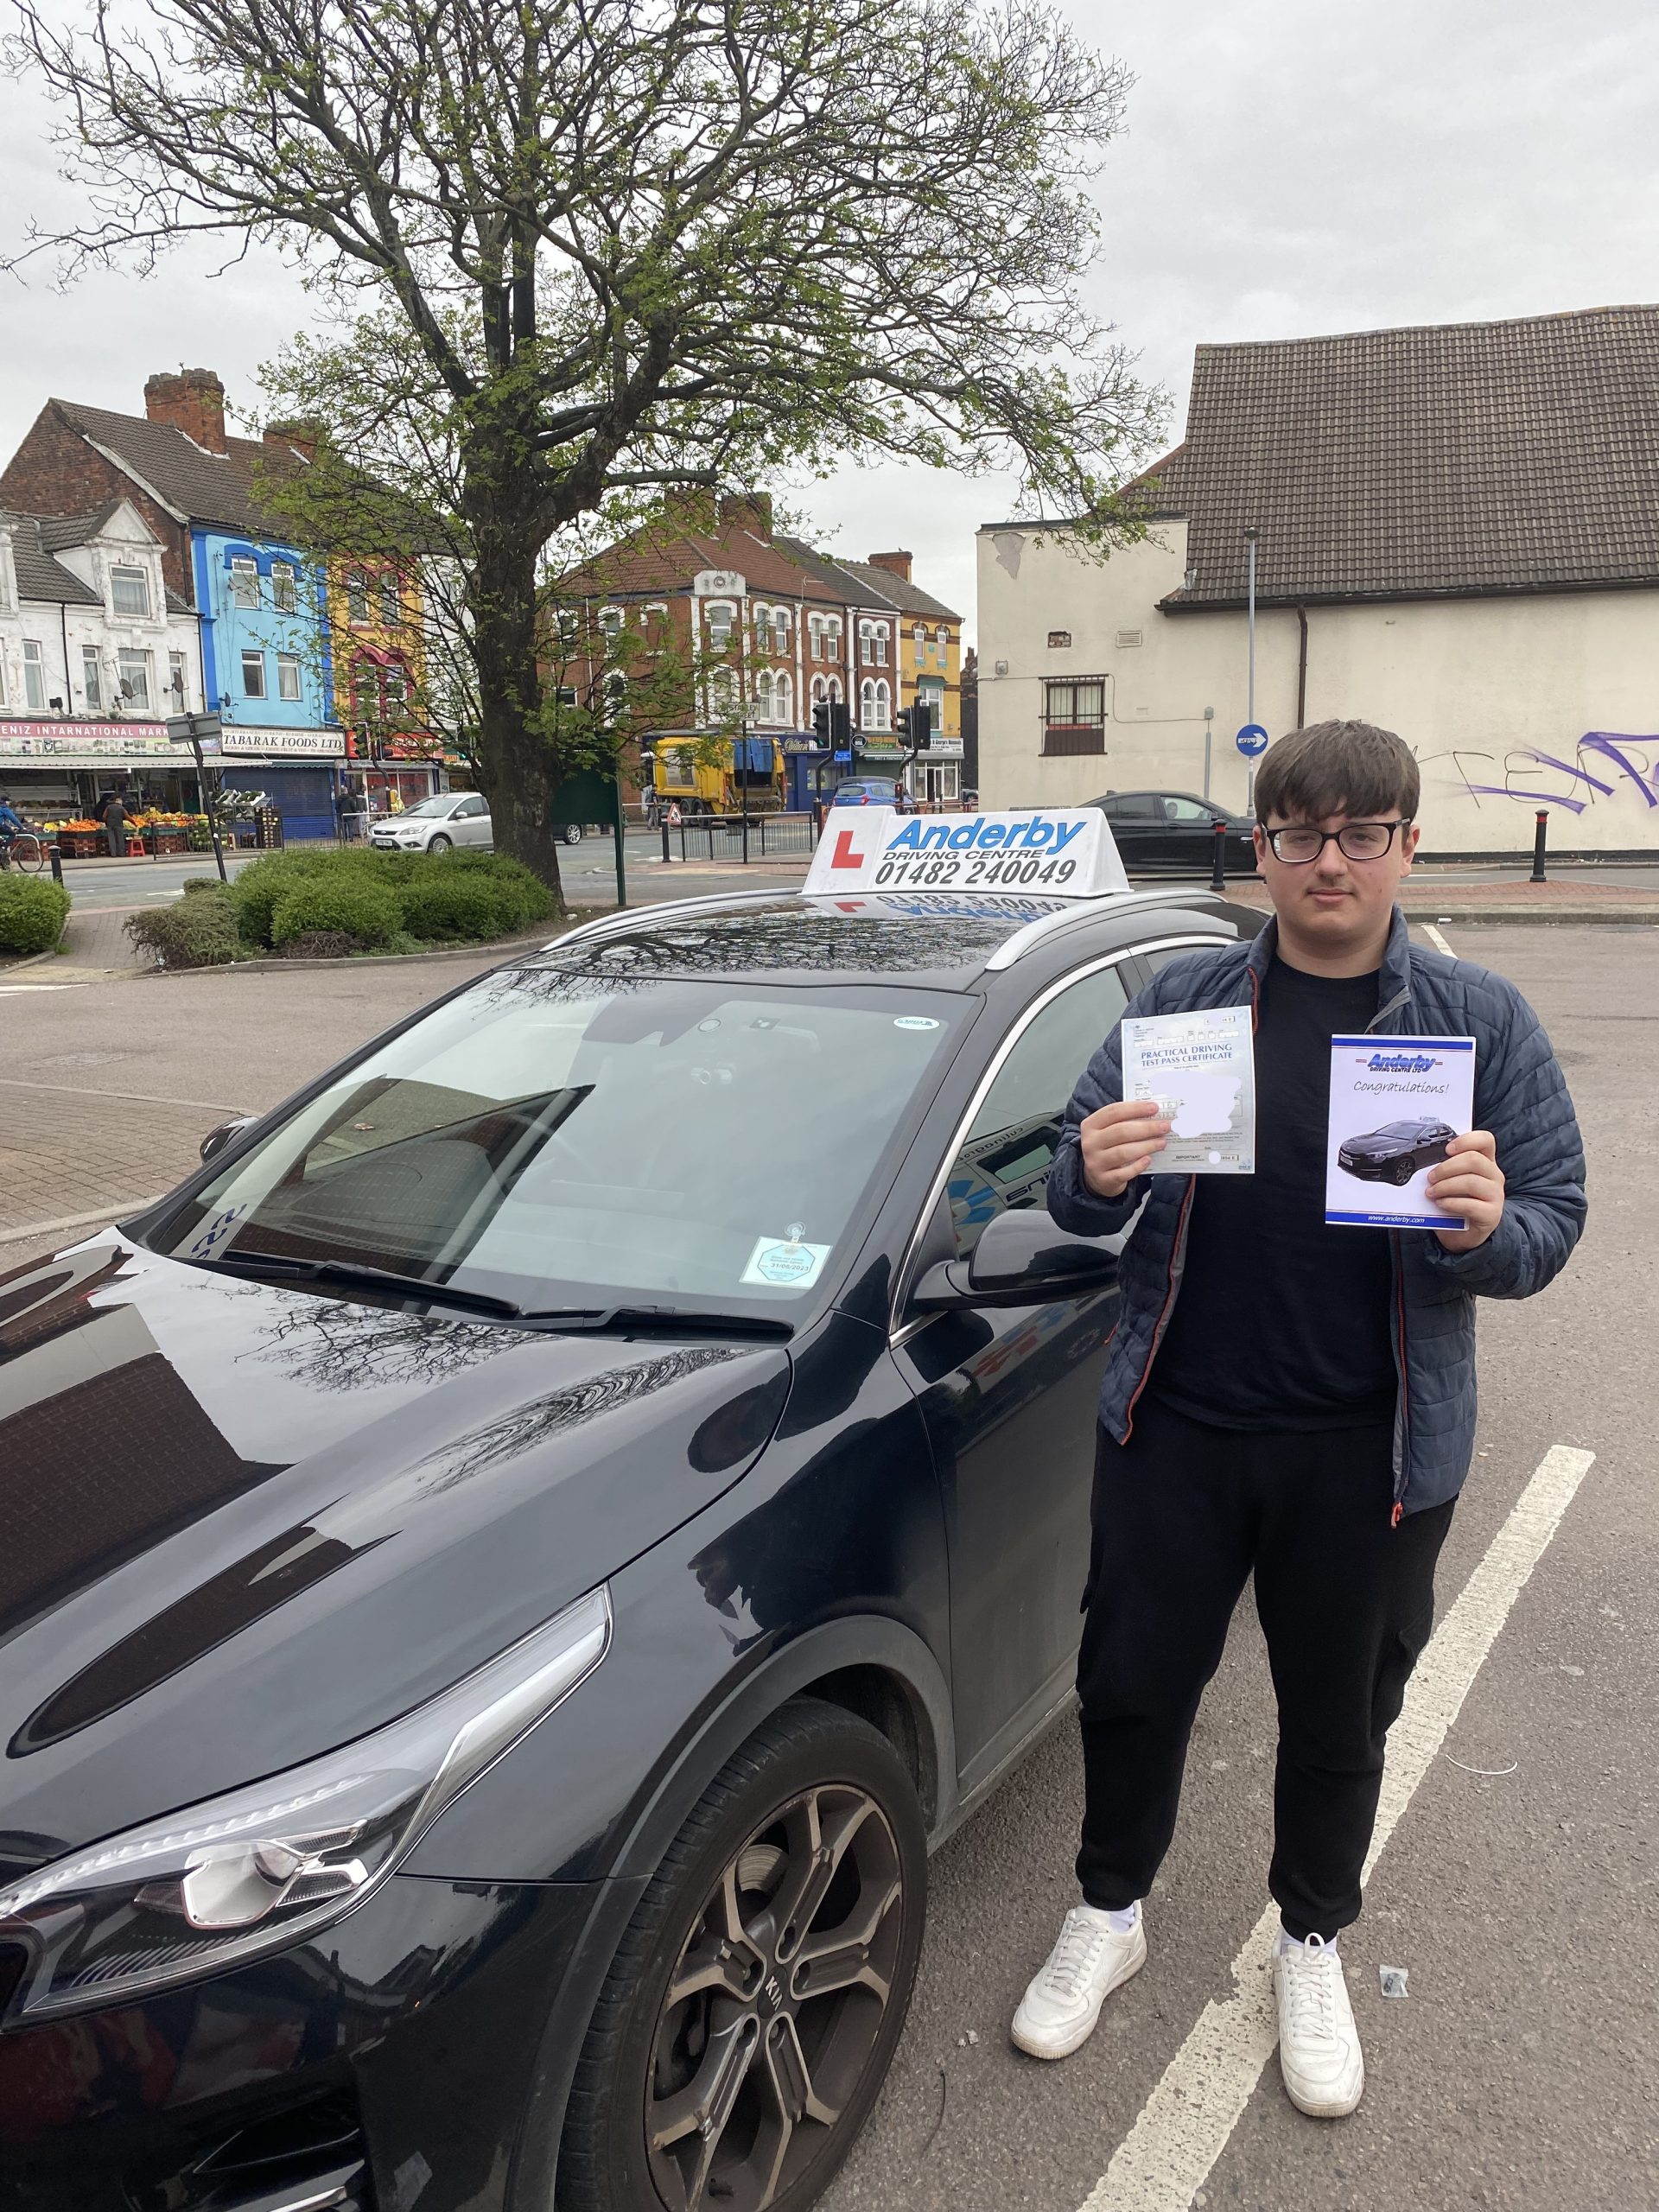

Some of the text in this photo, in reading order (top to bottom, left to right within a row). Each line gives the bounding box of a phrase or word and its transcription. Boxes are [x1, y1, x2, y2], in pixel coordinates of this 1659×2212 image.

[36, 726, 135, 736] INTARNATIONAL
[224, 734, 278, 747] TABARAK
[281, 737, 318, 747] FOODS
[321, 739, 342, 748] LTD
[886, 816, 1088, 855] Anderby
[831, 830, 865, 869] L
[882, 849, 1046, 861] DRIVING CENTRE
[874, 859, 1077, 886] 01482 240049
[1141, 1043, 1233, 1059] PRACTICAL DRIVING
[1141, 1058, 1160, 1067] TEST
[1182, 1052, 1233, 1062] CERTIFICATE
[1367, 1053, 1436, 1072] Anderby
[1353, 1081, 1450, 1095] Congratulations!
[1368, 1215, 1425, 1224] www.anderby.com
[765, 1974, 783, 2012] KIA
